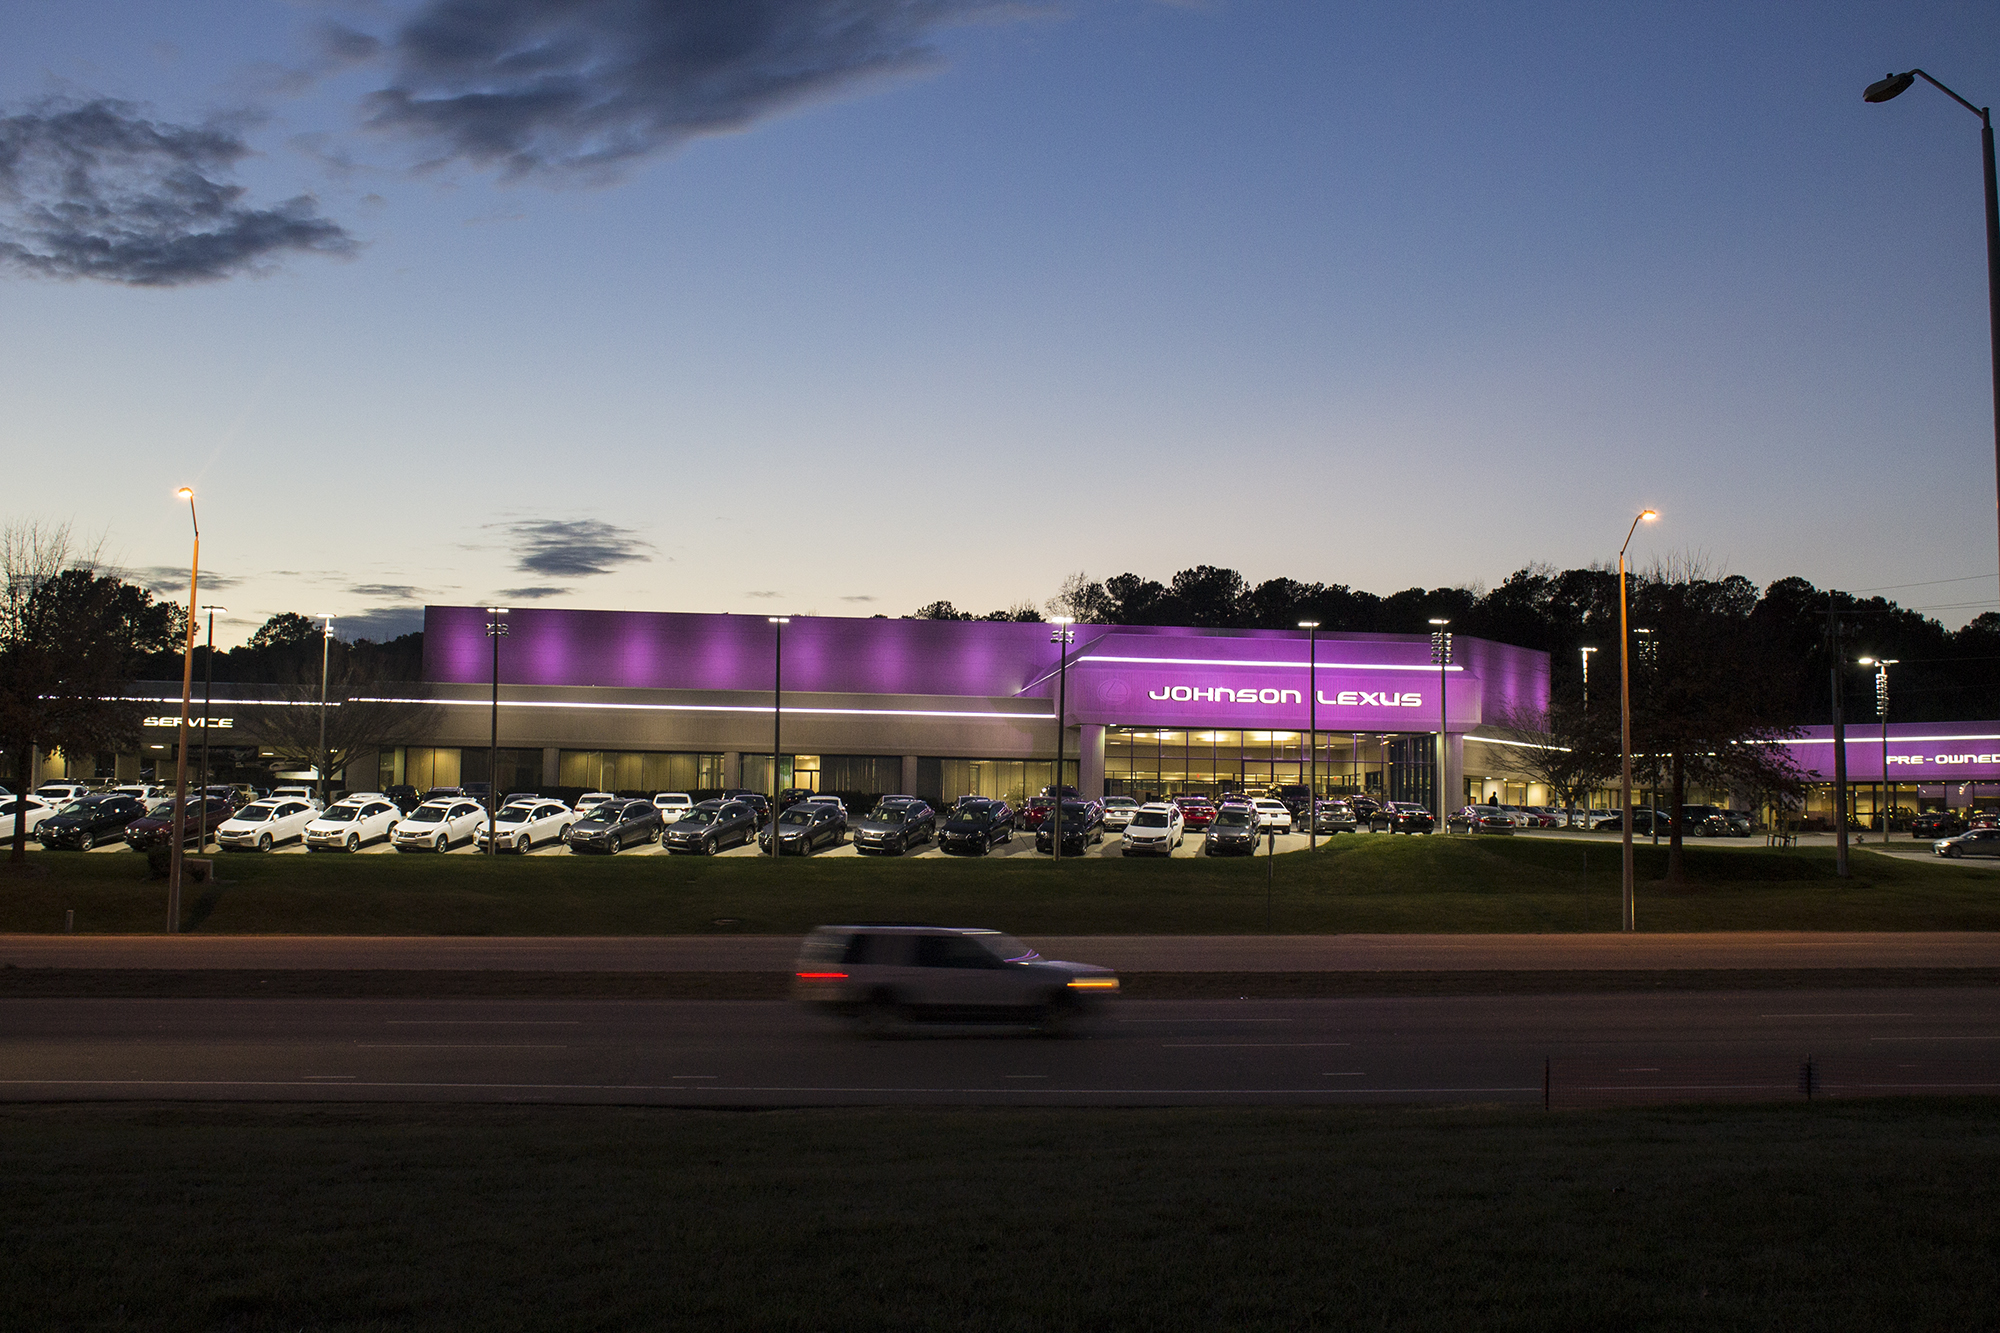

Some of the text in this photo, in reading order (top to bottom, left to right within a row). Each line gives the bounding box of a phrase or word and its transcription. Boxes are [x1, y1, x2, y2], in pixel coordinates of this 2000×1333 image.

[1149, 686, 1422, 707] JOHNSON LEXUS
[143, 717, 234, 728] SERVICE
